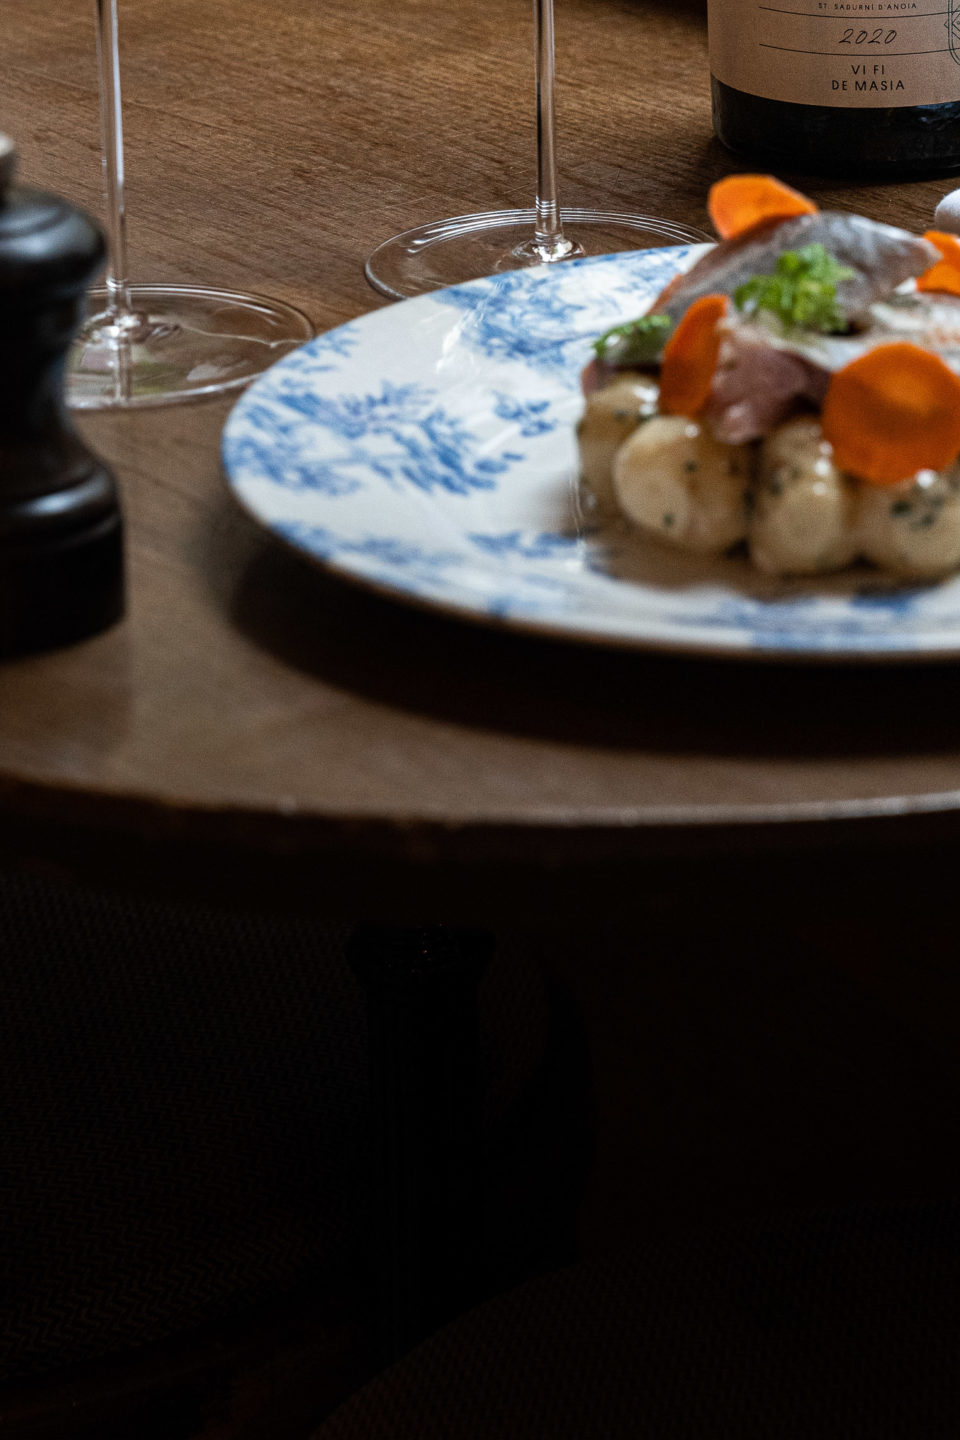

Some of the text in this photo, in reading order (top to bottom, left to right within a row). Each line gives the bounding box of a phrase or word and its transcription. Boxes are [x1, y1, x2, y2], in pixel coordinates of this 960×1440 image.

[838, 28, 898, 45] 2020
[851, 64, 886, 76] VI FI
[831, 79, 905, 92] DE MASIA
